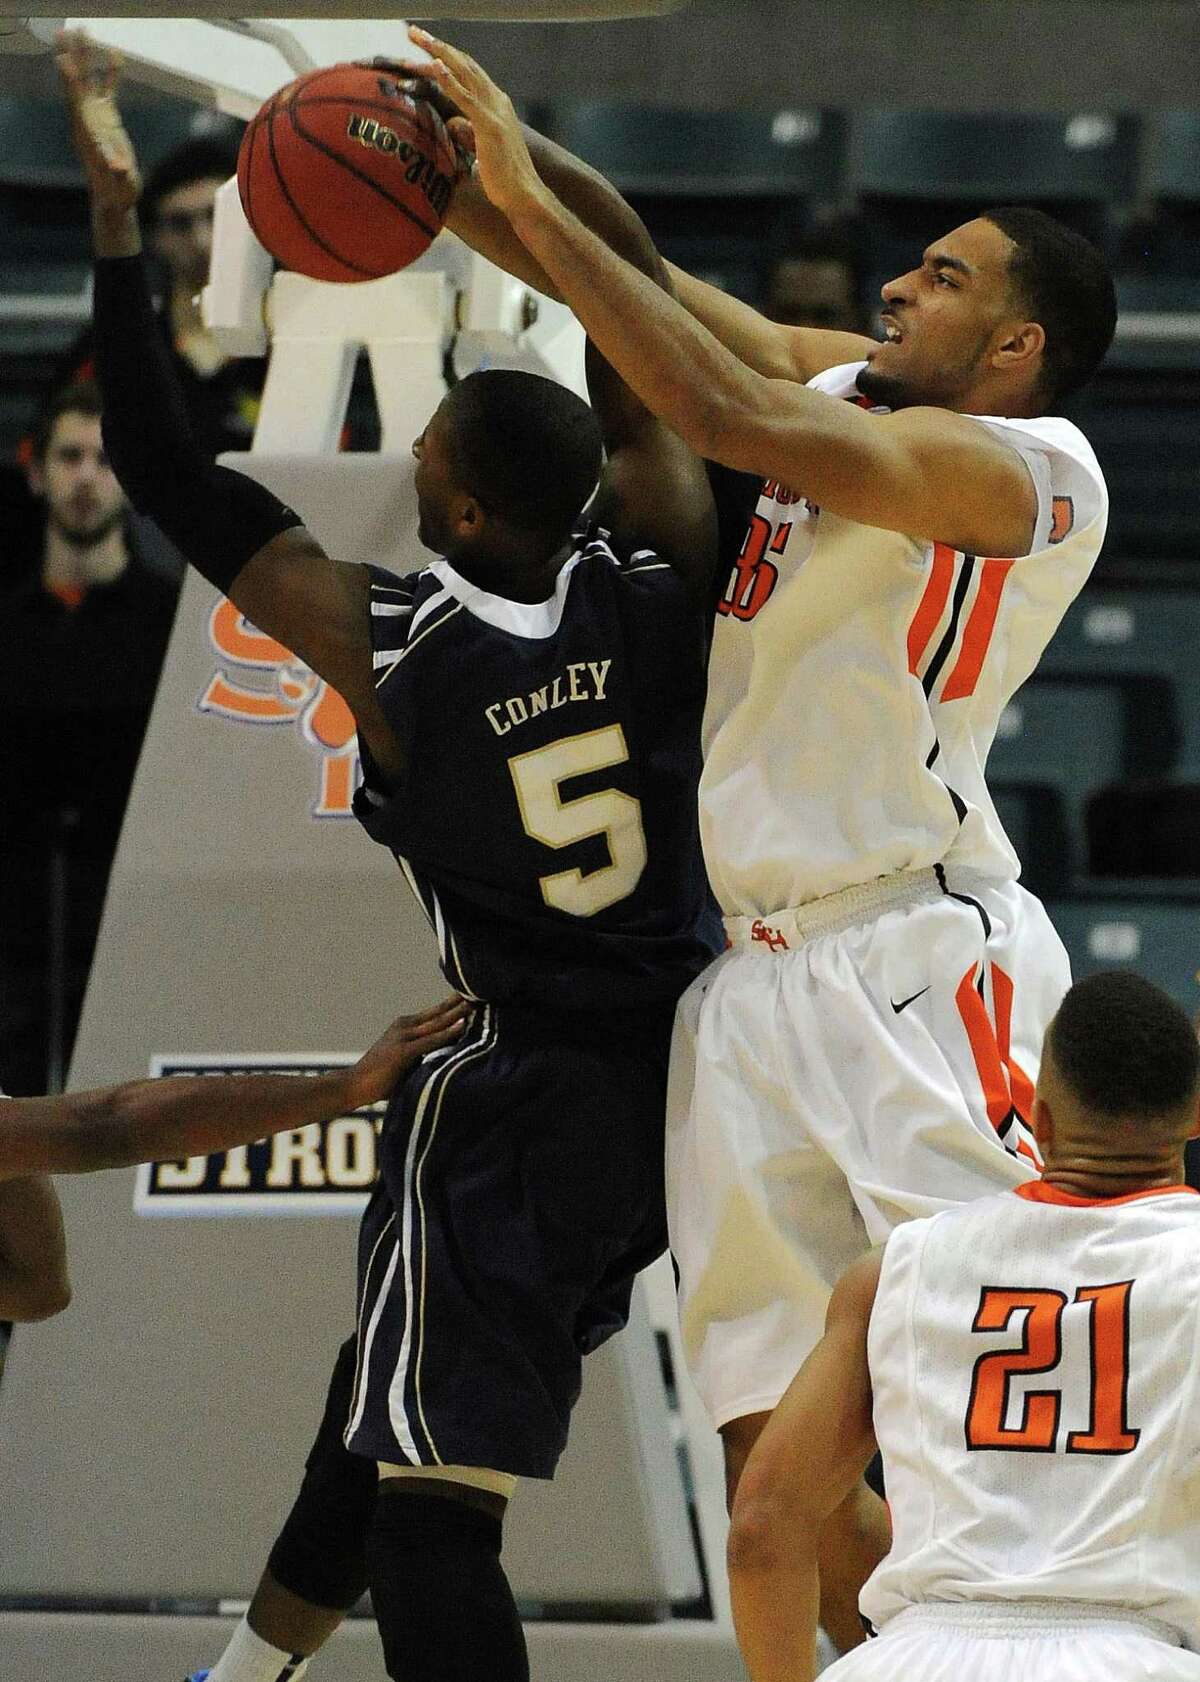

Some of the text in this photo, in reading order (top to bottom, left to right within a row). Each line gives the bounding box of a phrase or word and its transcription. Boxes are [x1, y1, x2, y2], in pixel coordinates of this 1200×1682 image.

[485, 659, 612, 736] CONLEY
[507, 722, 648, 918] 5
[964, 1278, 1142, 1456] 21
